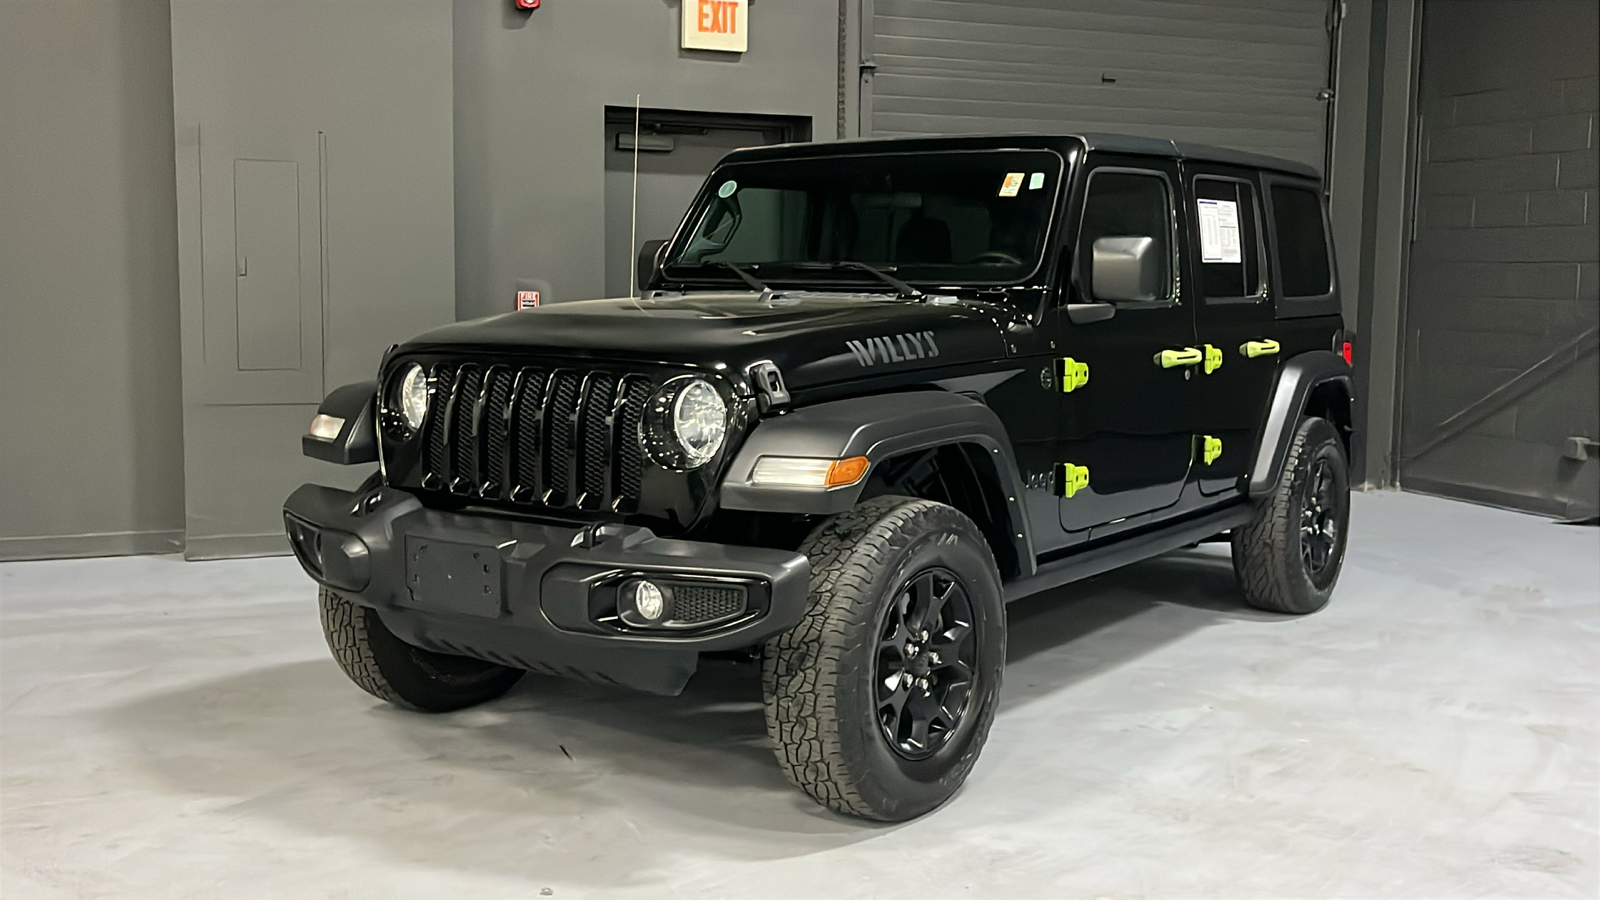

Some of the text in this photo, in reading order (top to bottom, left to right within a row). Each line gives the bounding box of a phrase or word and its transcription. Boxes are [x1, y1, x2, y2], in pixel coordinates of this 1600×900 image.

[698, 0, 738, 34] EXIT
[520, 292, 537, 300] FIRE
[845, 330, 939, 367] WILLYS
